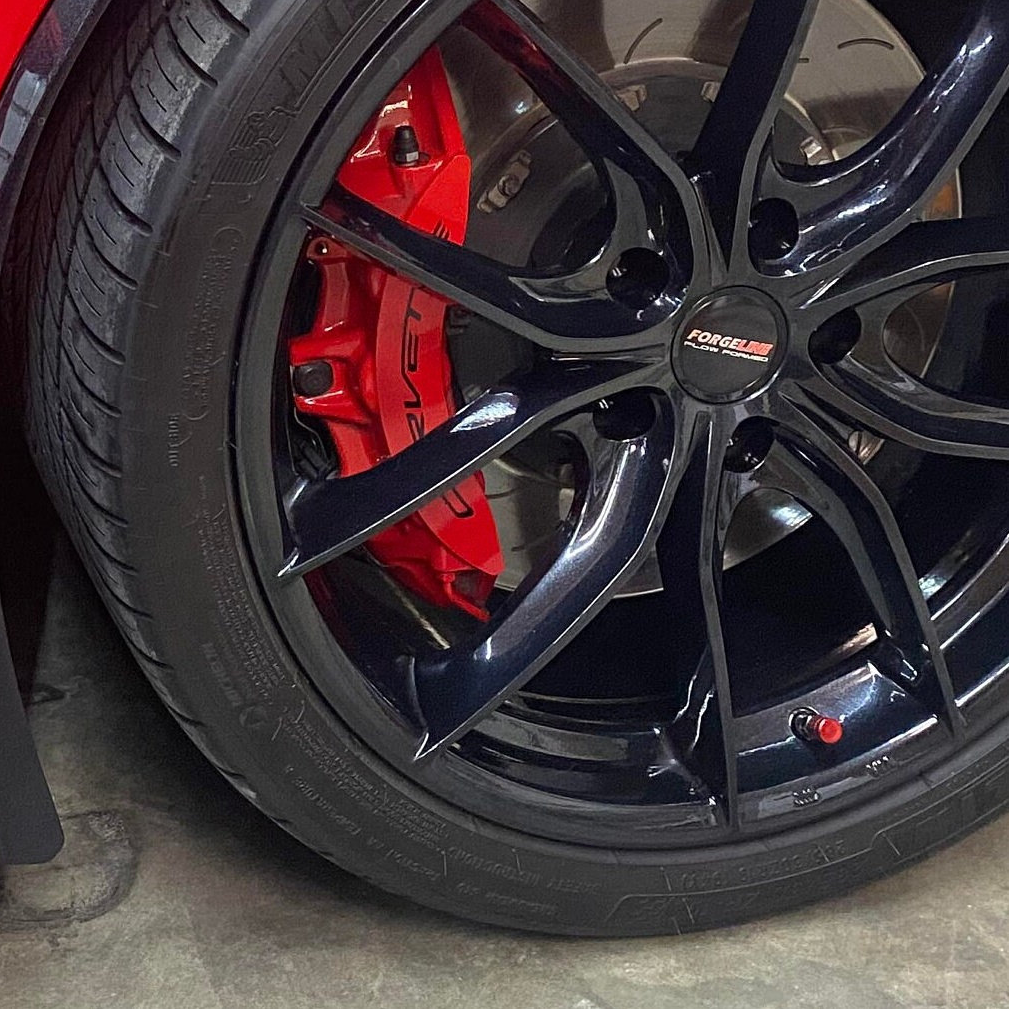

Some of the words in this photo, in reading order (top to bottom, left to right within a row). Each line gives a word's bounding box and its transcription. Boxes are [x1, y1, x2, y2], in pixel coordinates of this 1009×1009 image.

[684, 341, 719, 353] FLOW
[722, 350, 769, 362] FORMED
[687, 329, 773, 356] FORGELINE
